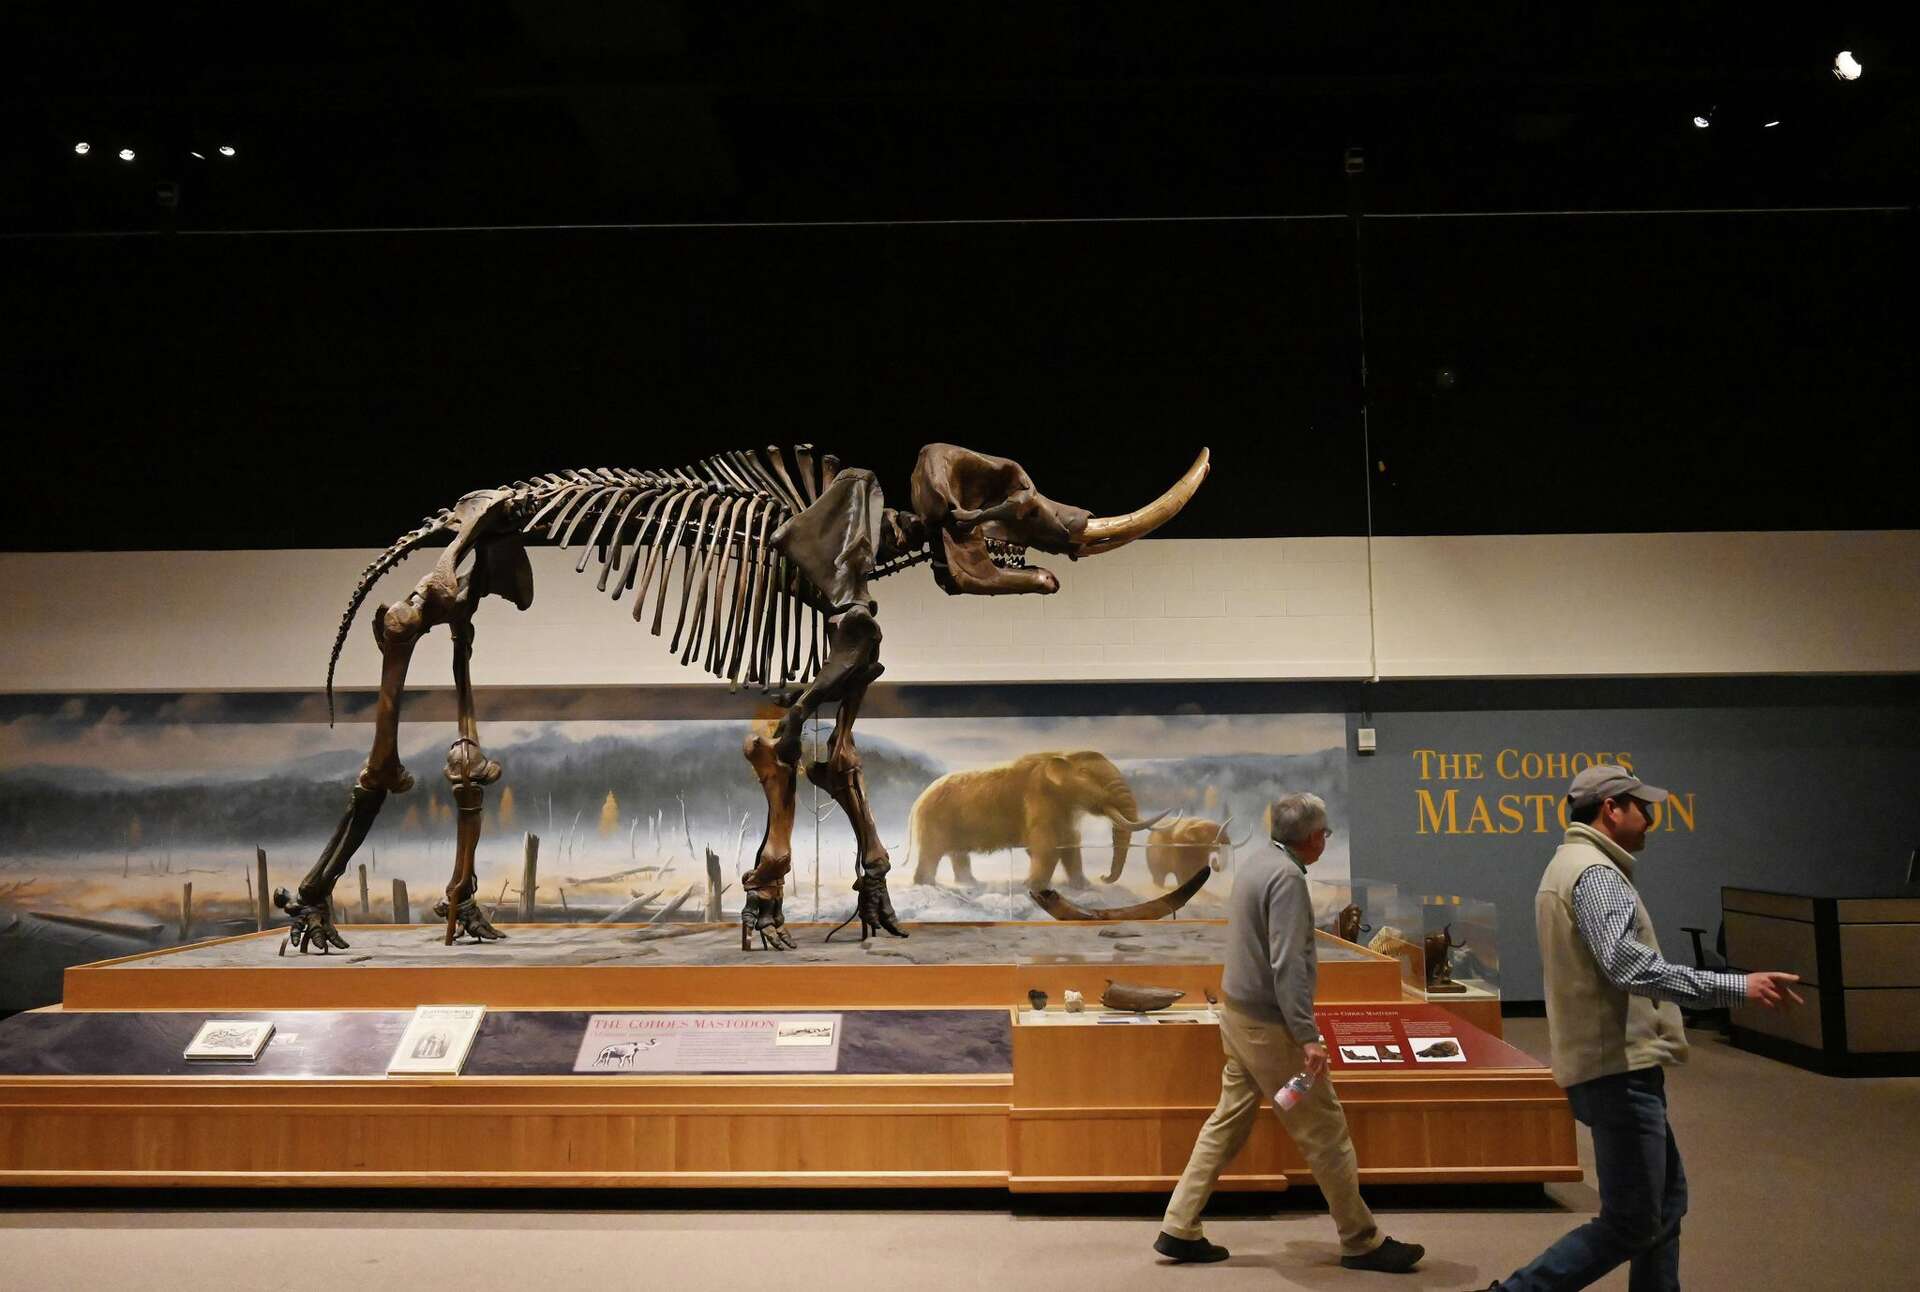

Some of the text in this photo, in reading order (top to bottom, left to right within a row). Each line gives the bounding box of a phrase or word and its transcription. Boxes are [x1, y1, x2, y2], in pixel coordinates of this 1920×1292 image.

[1412, 749, 1484, 780] THE
[594, 1019, 776, 1029] THE COHOES MASTODON
